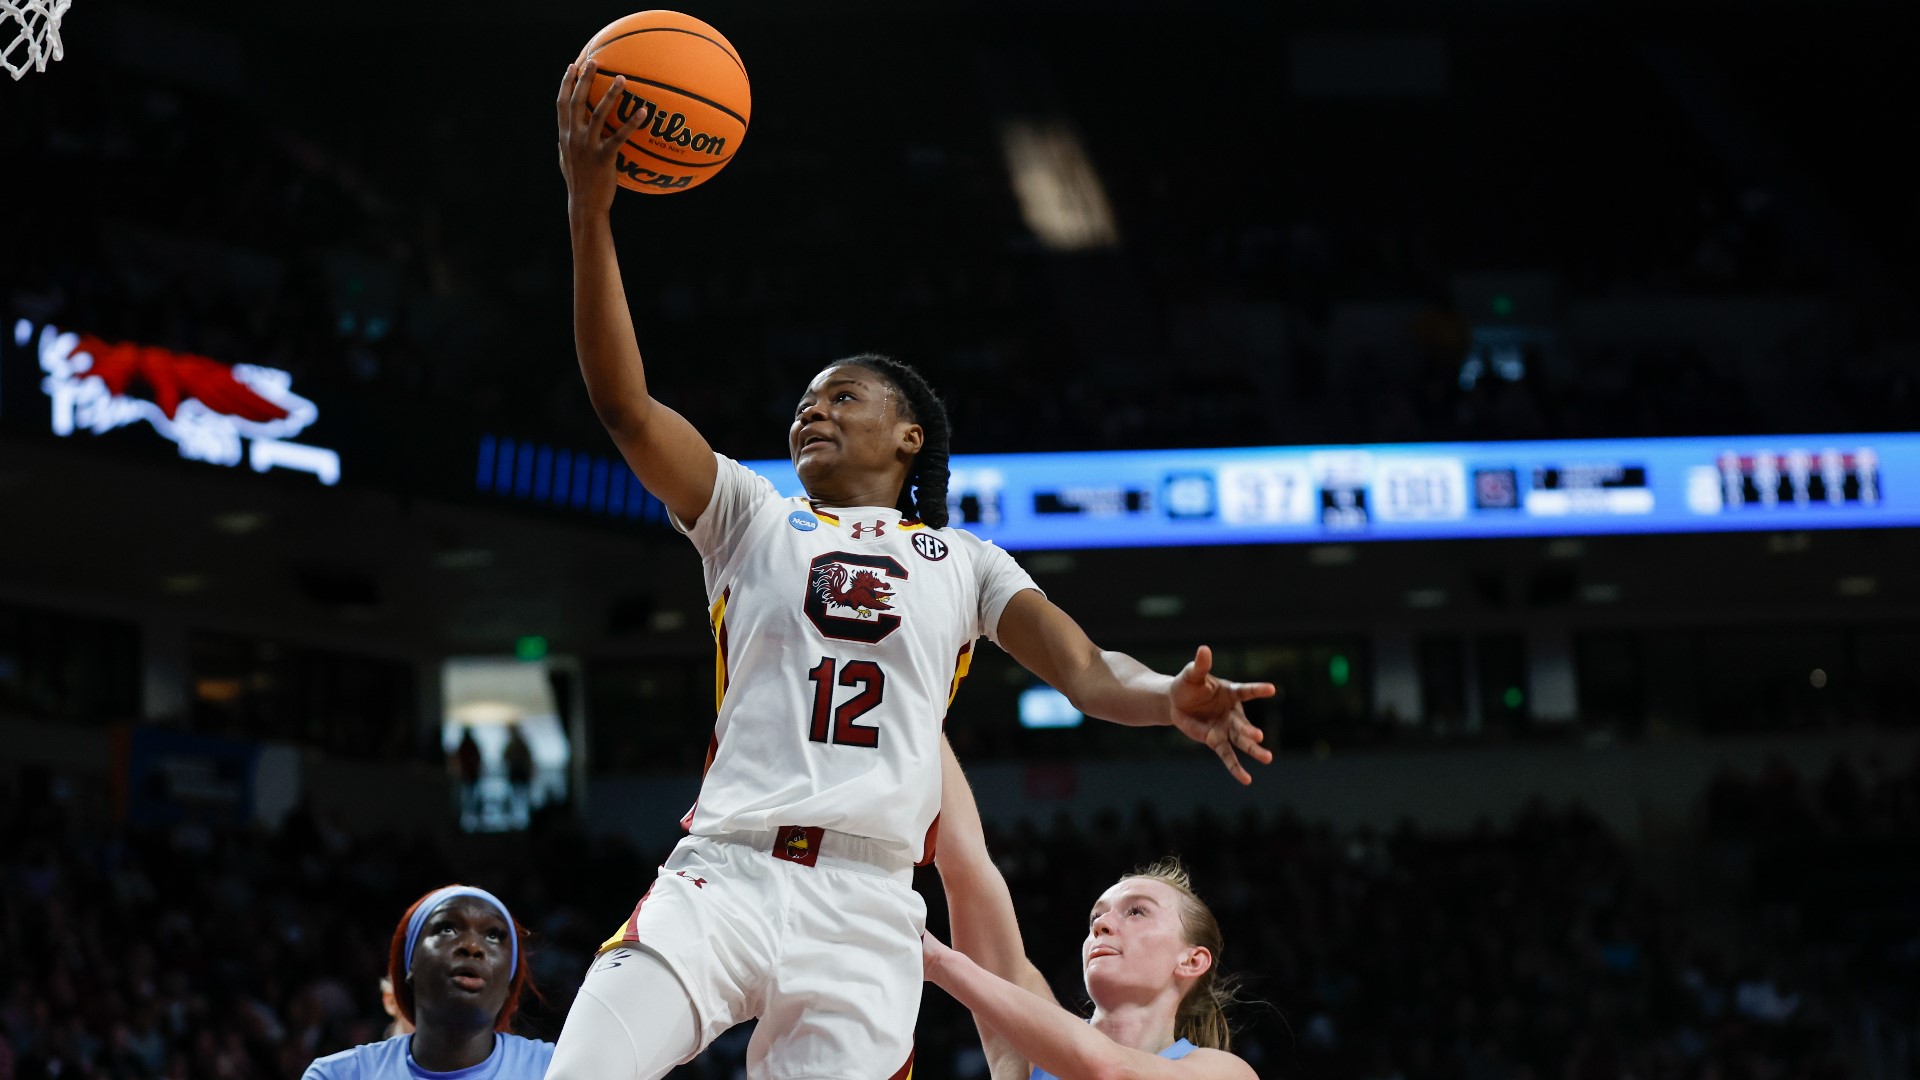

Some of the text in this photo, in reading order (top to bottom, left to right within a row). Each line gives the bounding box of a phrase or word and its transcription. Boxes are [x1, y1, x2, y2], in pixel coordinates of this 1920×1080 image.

[617, 90, 726, 155] Wilson
[648, 138, 686, 155] EVO NXT
[791, 517, 817, 529] NCAA
[914, 533, 946, 559] SEC
[808, 655, 886, 749] 12
